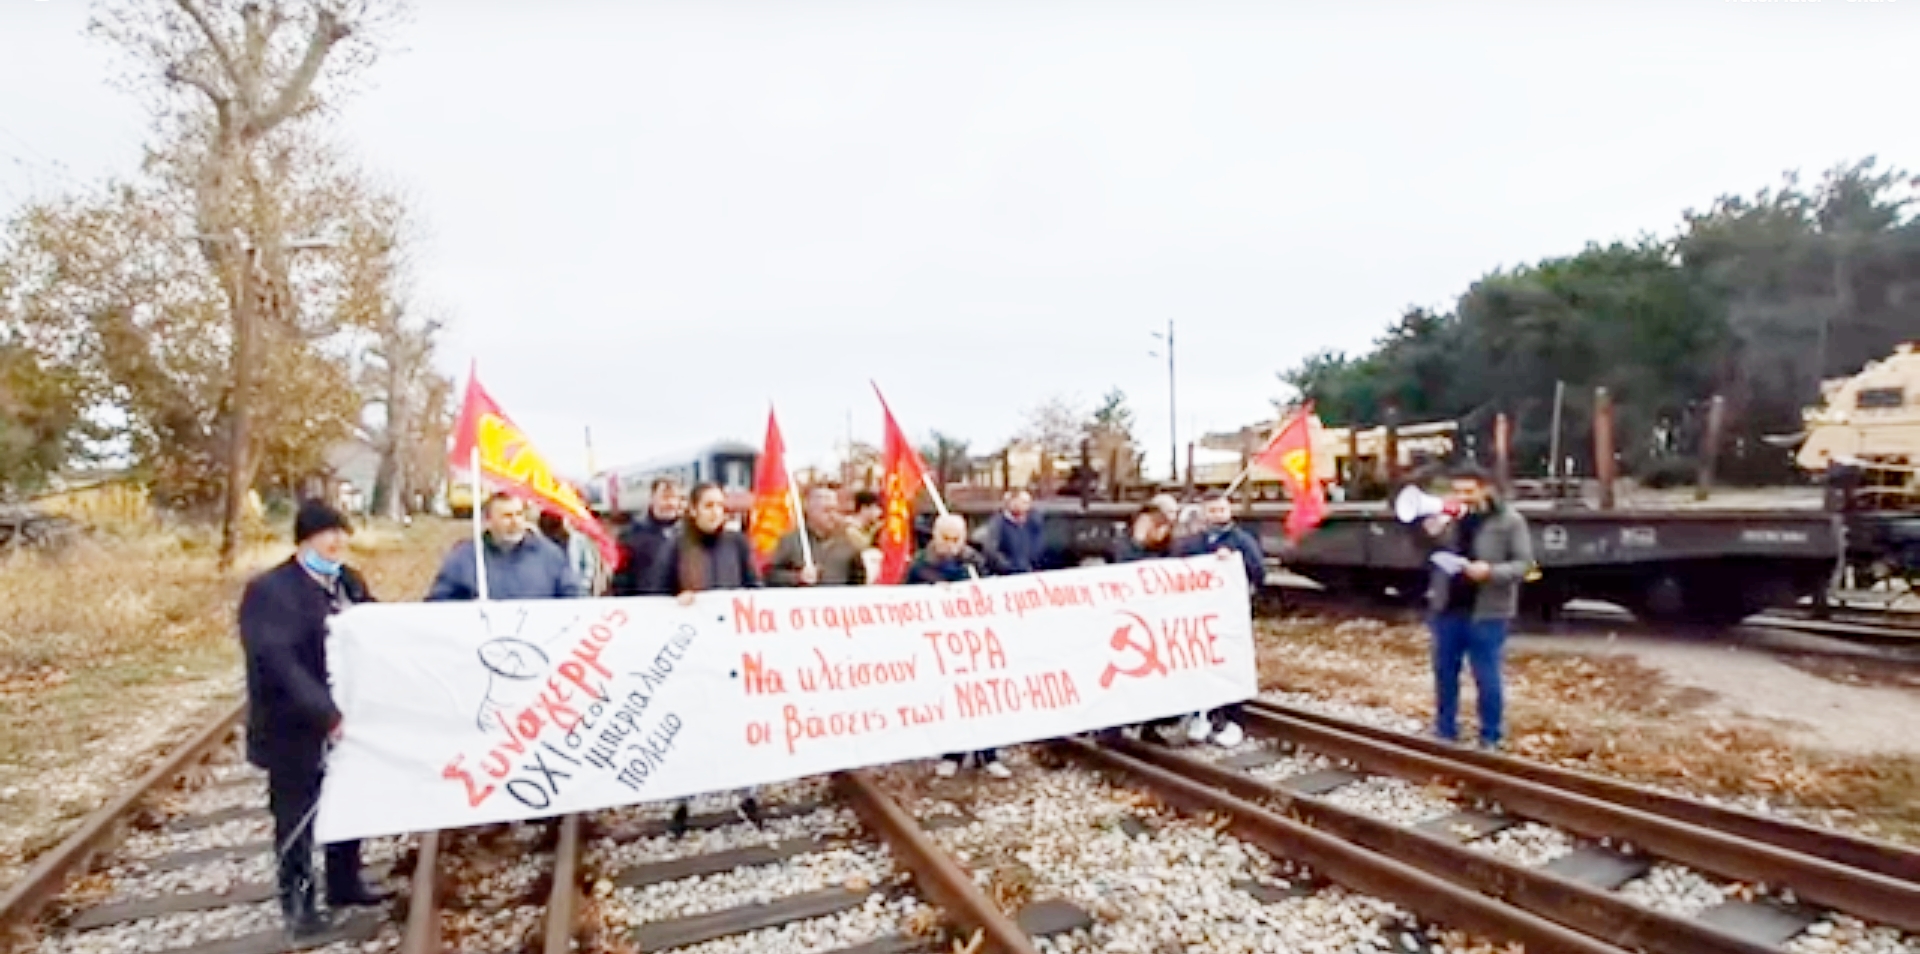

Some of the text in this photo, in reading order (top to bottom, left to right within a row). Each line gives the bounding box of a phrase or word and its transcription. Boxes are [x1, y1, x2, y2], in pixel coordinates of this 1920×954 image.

[732, 594, 777, 635] Να
[1161, 614, 1226, 670] ΚΚΕ
[742, 650, 786, 696] Να
[923, 627, 1008, 675] ΤΩΡΑ
[746, 721, 772, 747] οι
[897, 697, 946, 728] των
[505, 741, 582, 810] ΟΧΙ
